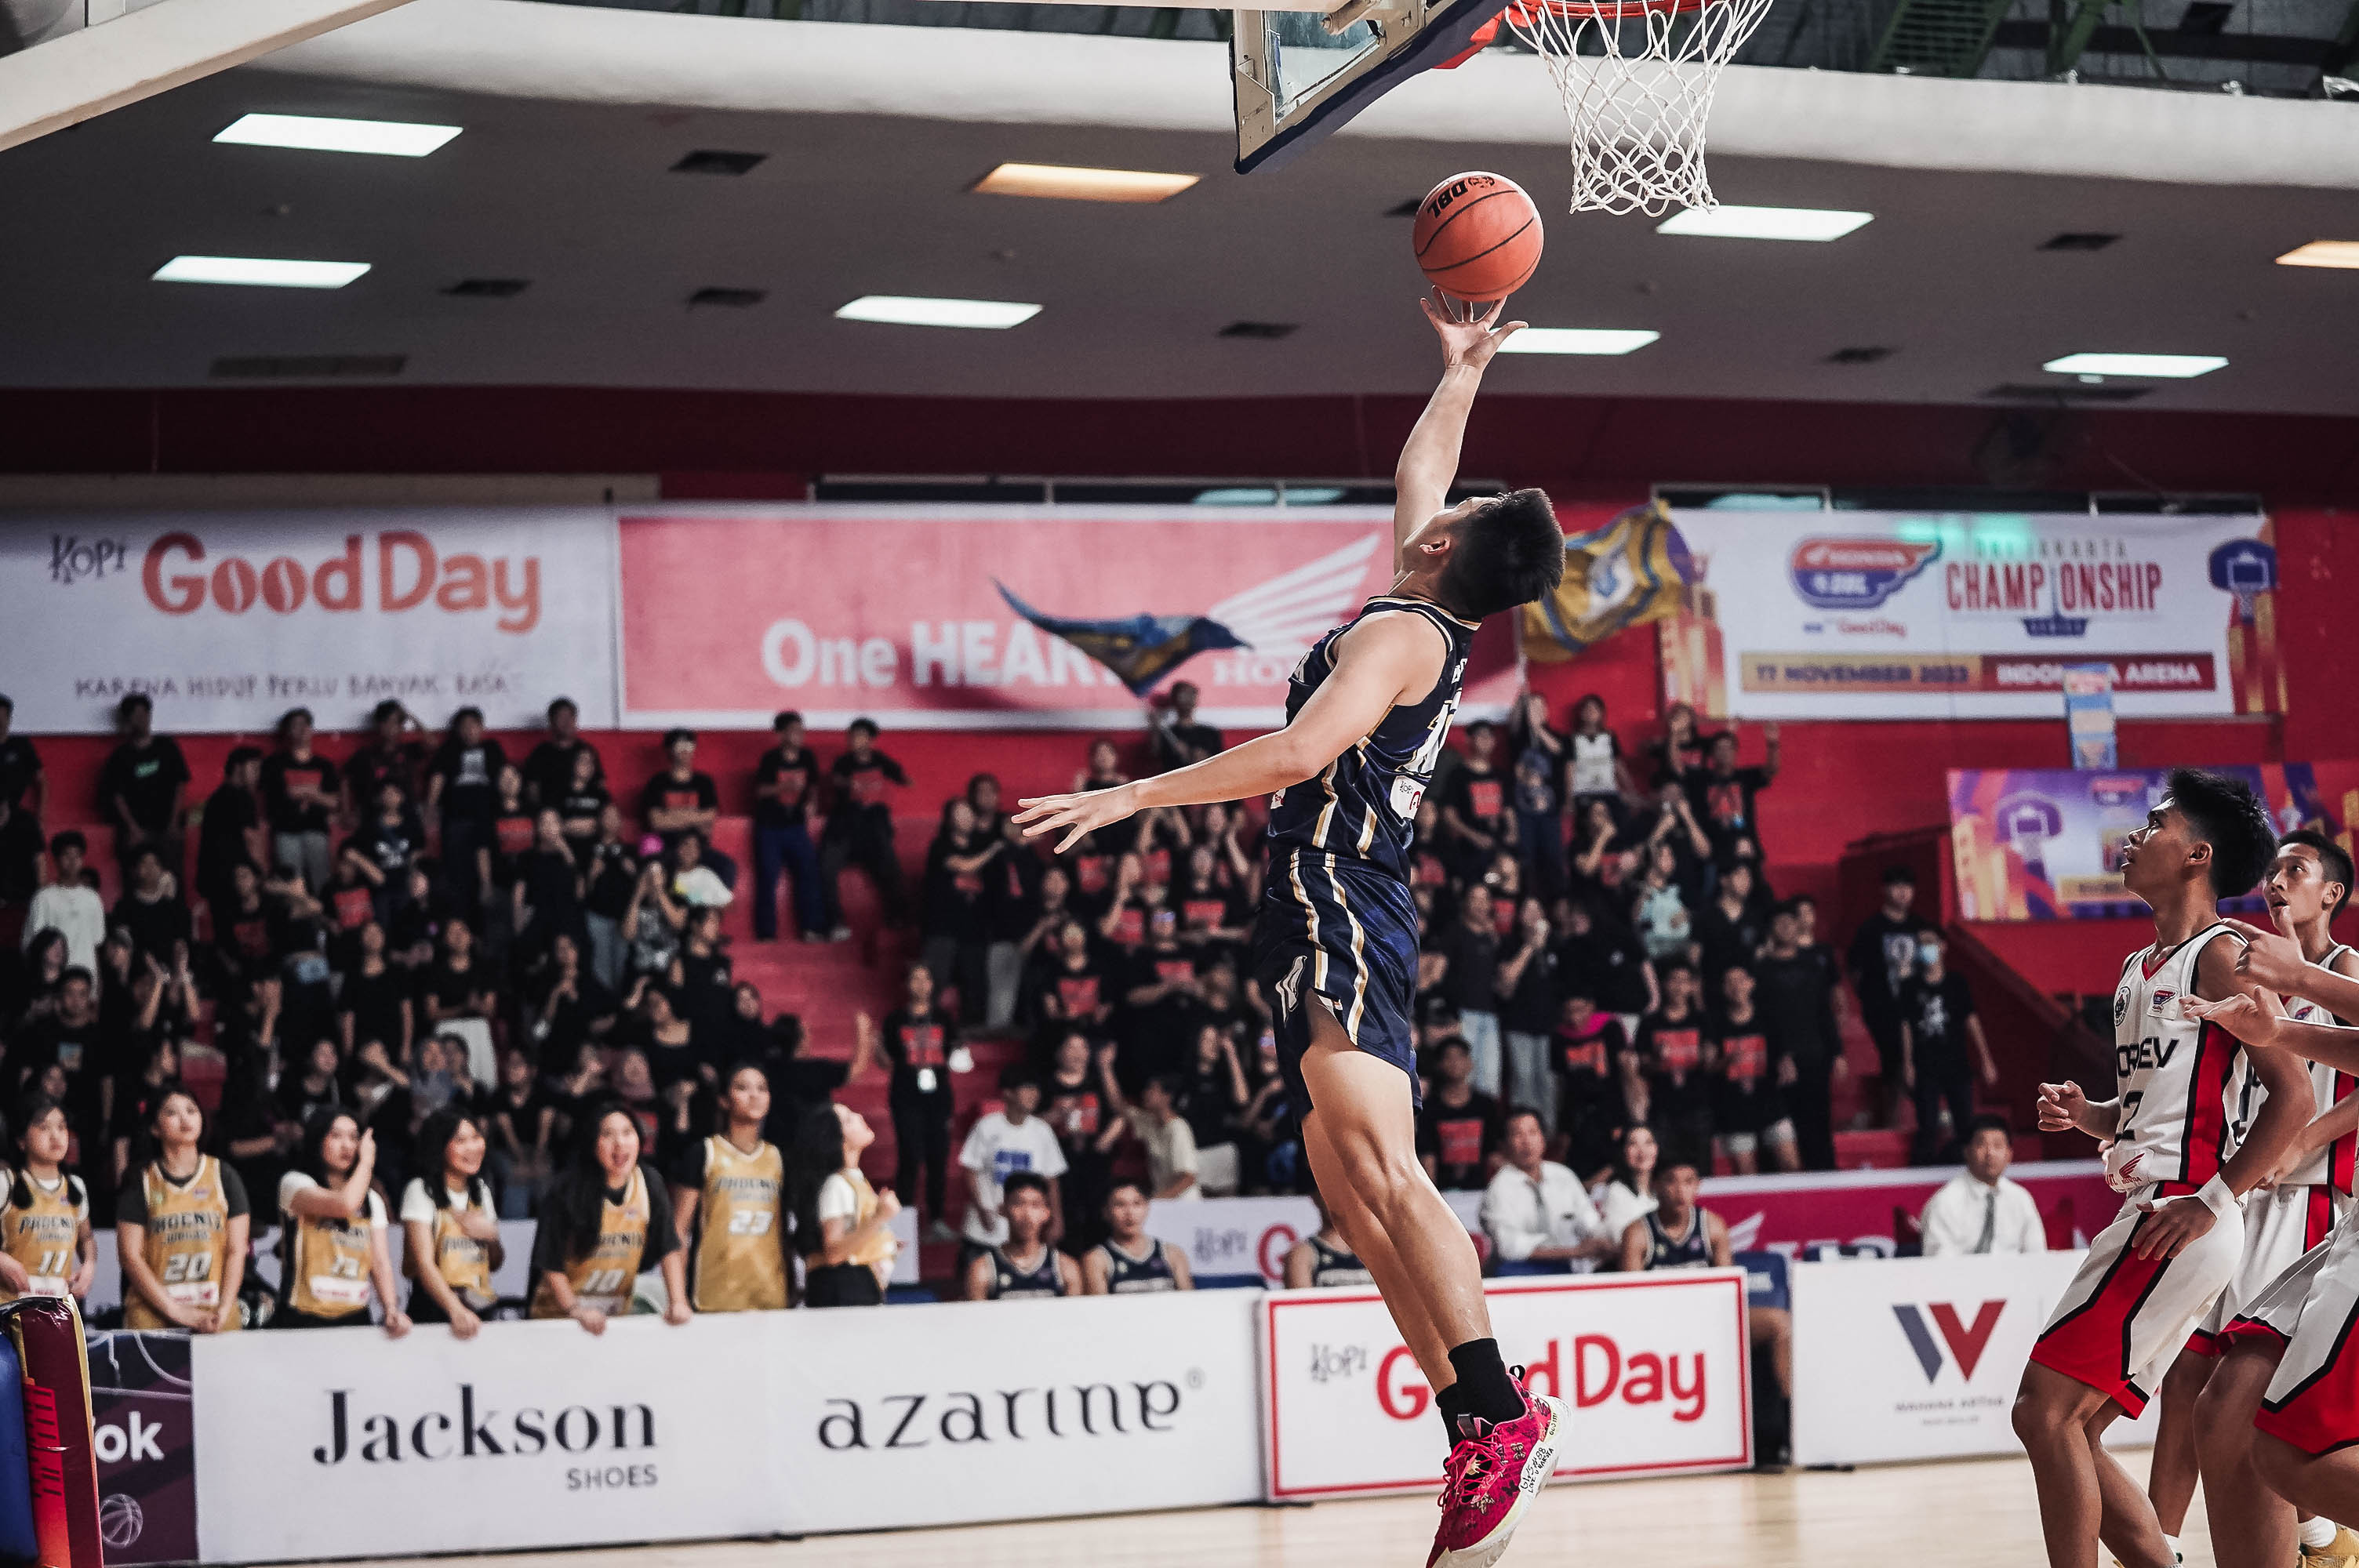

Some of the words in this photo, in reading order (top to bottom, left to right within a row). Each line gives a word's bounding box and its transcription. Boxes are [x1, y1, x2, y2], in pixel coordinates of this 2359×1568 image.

[1427, 179, 1469, 219] DBL
[141, 531, 363, 615] Good
[378, 530, 541, 635] Day
[763, 619, 899, 688] One
[912, 619, 1121, 687] HEAR
[1785, 664, 1912, 683] NOVEMBER
[2125, 663, 2202, 684] ARENA
[729, 1210, 773, 1235] 23
[164, 1252, 213, 1282] 20
[1575, 1334, 1706, 1422] Day
[313, 1385, 657, 1465] Jackson
[566, 1465, 659, 1491] SHOES
